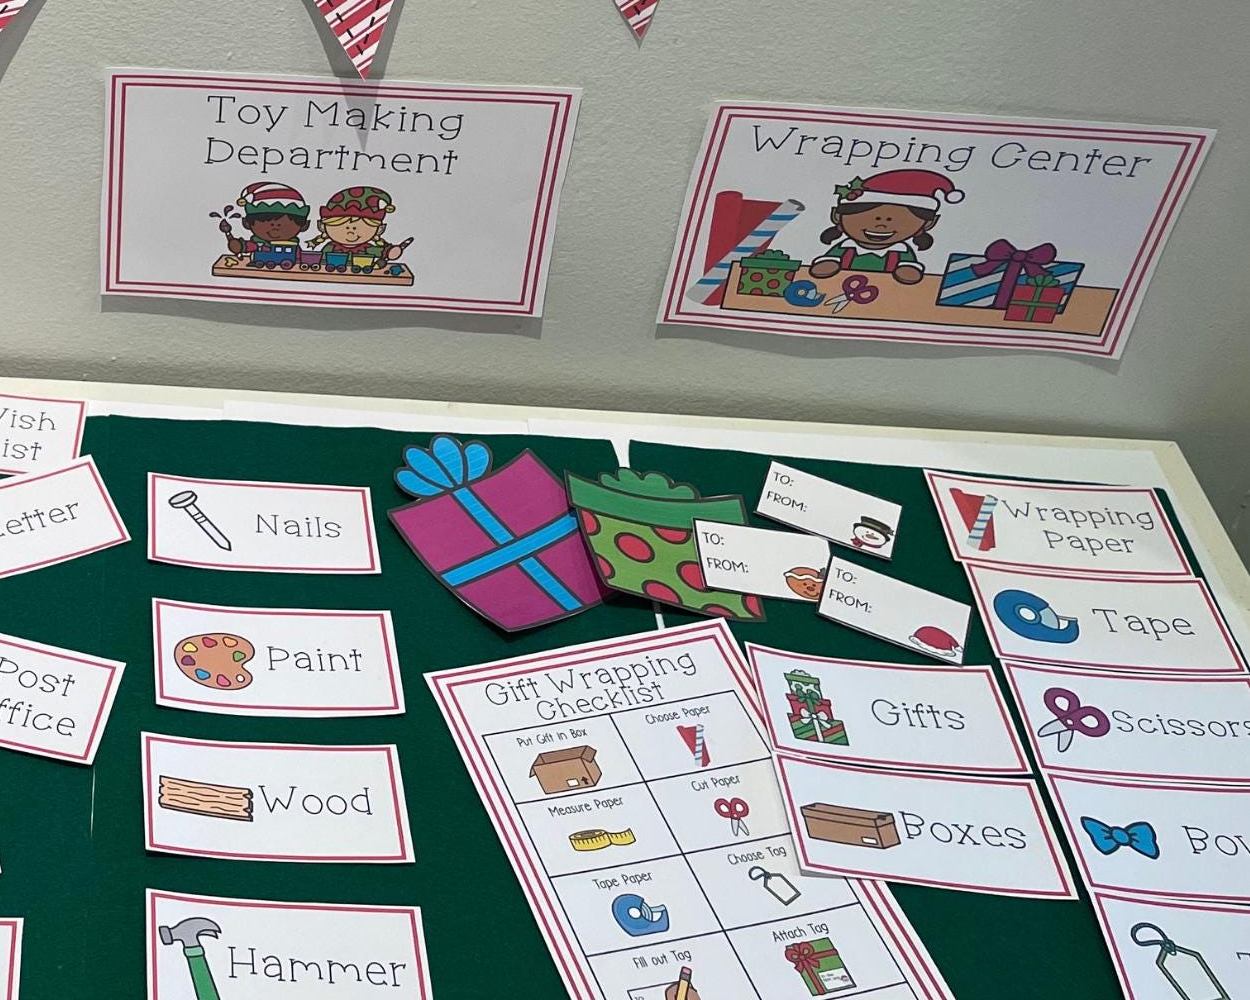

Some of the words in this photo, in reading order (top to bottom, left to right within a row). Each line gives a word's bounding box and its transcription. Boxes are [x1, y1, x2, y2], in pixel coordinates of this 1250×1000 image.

[207, 95, 289, 132] Toy
[303, 100, 465, 140] Making
[204, 136, 459, 175] Department
[752, 124, 977, 173] Wrapping
[990, 141, 1153, 180] Center
[774, 472, 794, 486] TO:
[767, 491, 806, 512] FROM:
[256, 514, 341, 538] Nails
[1000, 497, 1155, 532] Wrapping
[702, 532, 724, 545] TO:
[1042, 529, 1135, 556] Paper
[707, 557, 748, 573] FROM:
[836, 568, 857, 584] TO:
[829, 589, 871, 613] FROM:
[1092, 609, 1195, 641] Tape
[267, 646, 361, 671] Paint
[484, 677, 541, 707] Gift
[545, 650, 698, 693] Wrapping
[535, 681, 666, 722] Checklist
[645, 712, 680, 724] Choose
[682, 706, 710, 717] Paper
[872, 699, 964, 730] Gifts
[516, 738, 532, 747] Put
[536, 733, 553, 744] Gift
[569, 729, 587, 738] Box
[691, 780, 709, 791] Cut
[711, 776, 740, 787] Paper
[258, 785, 372, 815] Wood
[548, 803, 592, 816] Measure
[594, 798, 623, 809] Paper
[899, 810, 1028, 850] Boxes
[728, 852, 764, 865] Choose
[766, 847, 786, 857] Tag
[592, 879, 619, 890] Tape
[621, 873, 652, 885] Paper
[772, 926, 807, 943] Attach
[808, 923, 829, 934] Tag
[228, 947, 406, 986] Hammer
[633, 957, 648, 968] Fill
[651, 954, 668, 965] out
[670, 951, 691, 961] Tag
